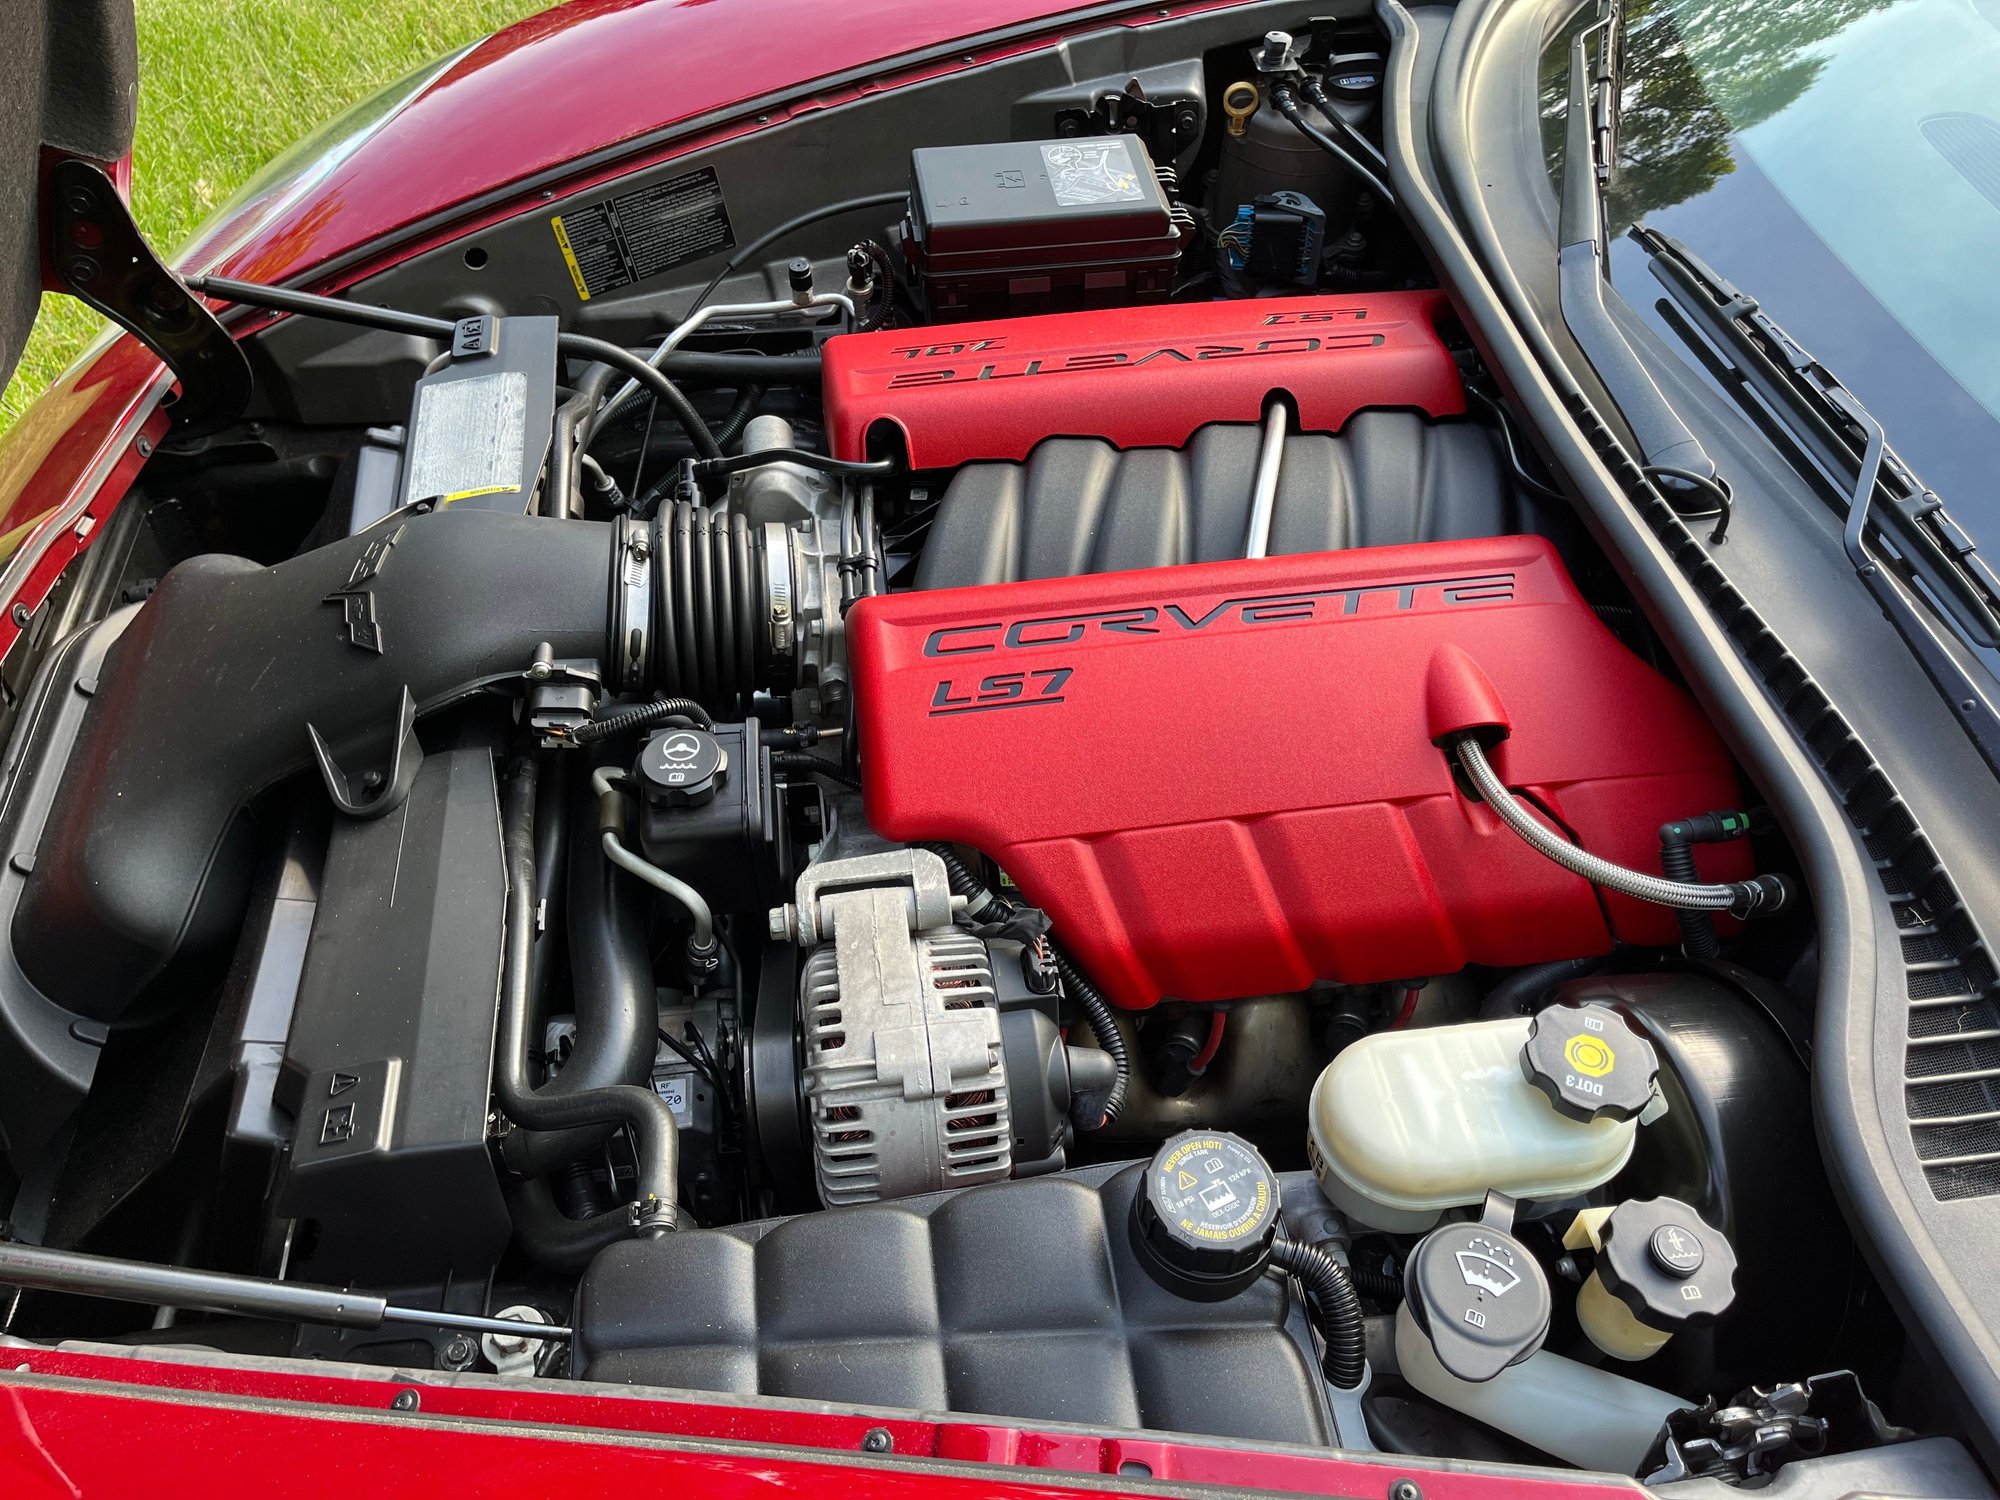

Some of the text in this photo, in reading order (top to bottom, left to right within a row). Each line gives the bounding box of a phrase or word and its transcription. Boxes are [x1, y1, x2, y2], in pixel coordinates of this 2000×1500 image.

[555, 225, 565, 242] CAUTION
[570, 265, 582, 286] ATTENTION
[885, 333, 1385, 389] CORVETTE
[924, 574, 1516, 658] CORVETTE
[931, 668, 1074, 708] LS7
[1566, 1074, 1604, 1096] DOT 3
[1162, 1141, 1221, 1172] NEVER OPEN HOT!
[1178, 1149, 1208, 1166] SURGE TANK
[1228, 1167, 1251, 1182] 124 kPa
[1180, 1219, 1193, 1229] NE
[1193, 1224, 1227, 1239] JAMAIS
[1229, 1218, 1256, 1237] OUVRIR
[1257, 1181, 1266, 1212] CHAUD!
[1183, 1195, 1194, 1206] PSI
